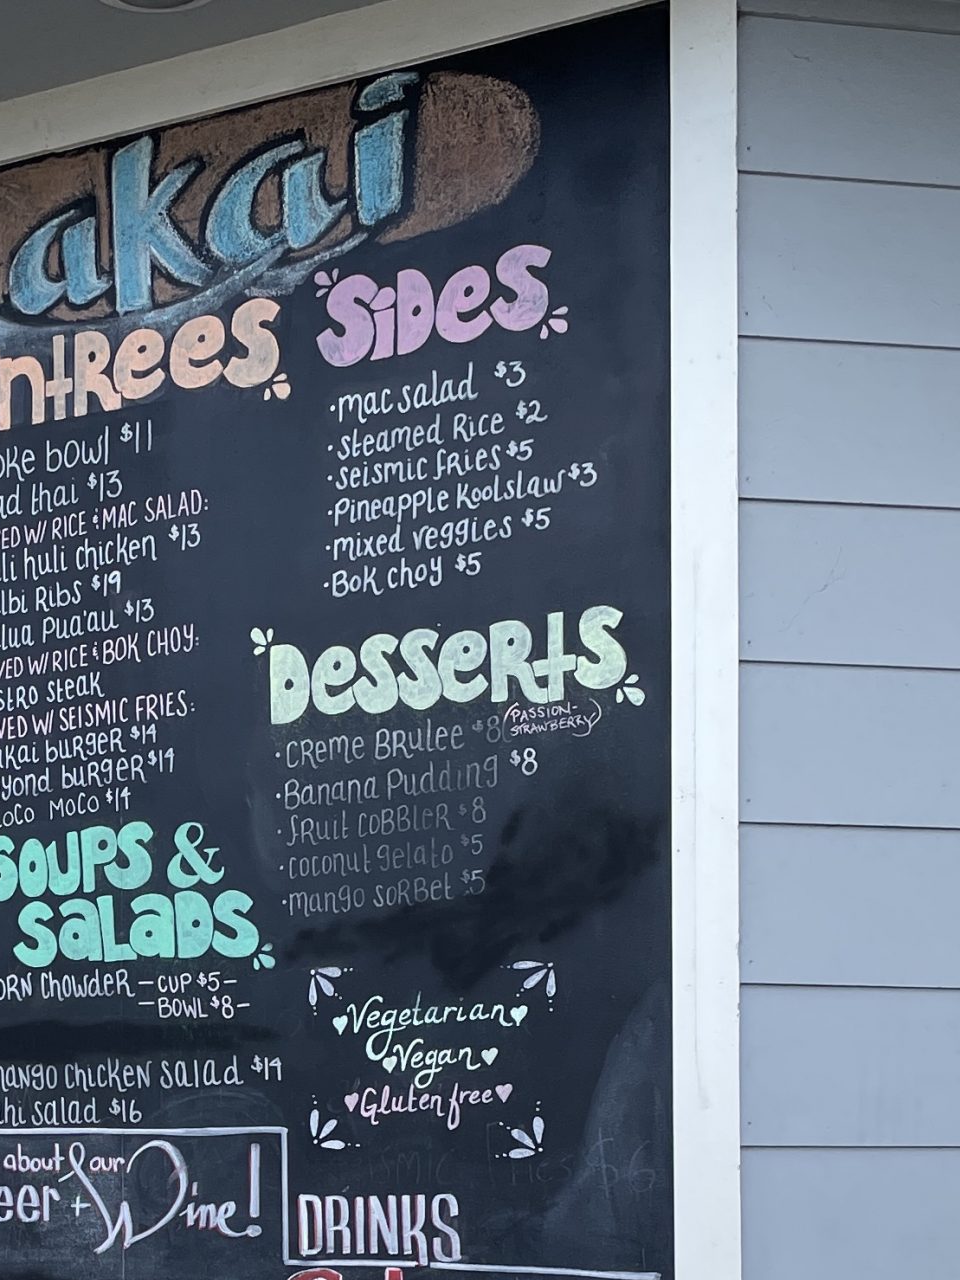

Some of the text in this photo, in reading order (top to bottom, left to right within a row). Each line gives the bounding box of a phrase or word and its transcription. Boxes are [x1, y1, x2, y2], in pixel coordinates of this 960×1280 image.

[494, 361, 528, 388] $3
[515, 400, 548, 425] $2
[120, 419, 153, 454] $11
[505, 438, 535, 463] $5
[87, 469, 123, 502] $13
[568, 462, 598, 488] $3
[23, 520, 47, 544] W/
[51, 510, 88, 541] RICE
[102, 501, 137, 531] MAC
[144, 489, 209, 523] SALAD:
[521, 506, 552, 532] $5
[23, 544, 68, 582] huli
[168, 523, 201, 551] $13
[454, 551, 483, 577] $5
[91, 570, 122, 597] $19
[124, 598, 155, 623] $13
[52, 644, 89, 673] RICE
[102, 632, 142, 665] BOK
[31, 709, 54, 736] W/
[59, 697, 129, 732] SEISMIC
[135, 689, 195, 722] FRIES:
[129, 723, 158, 745] $14
[147, 747, 175, 773] $14
[509, 747, 539, 776] $8
[105, 786, 131, 811] $14
[166, 821, 225, 889] &
[346, 991, 514, 1062] Vegetarian
[250, 1054, 283, 1082] $14
[392, 1038, 481, 1090] Vegan
[108, 1098, 143, 1124] $16
[359, 1082, 494, 1131] Gluten free
[3, 1142, 65, 1172] about
[89, 1153, 125, 1172] our
[297, 1192, 461, 1267] DRINKS
